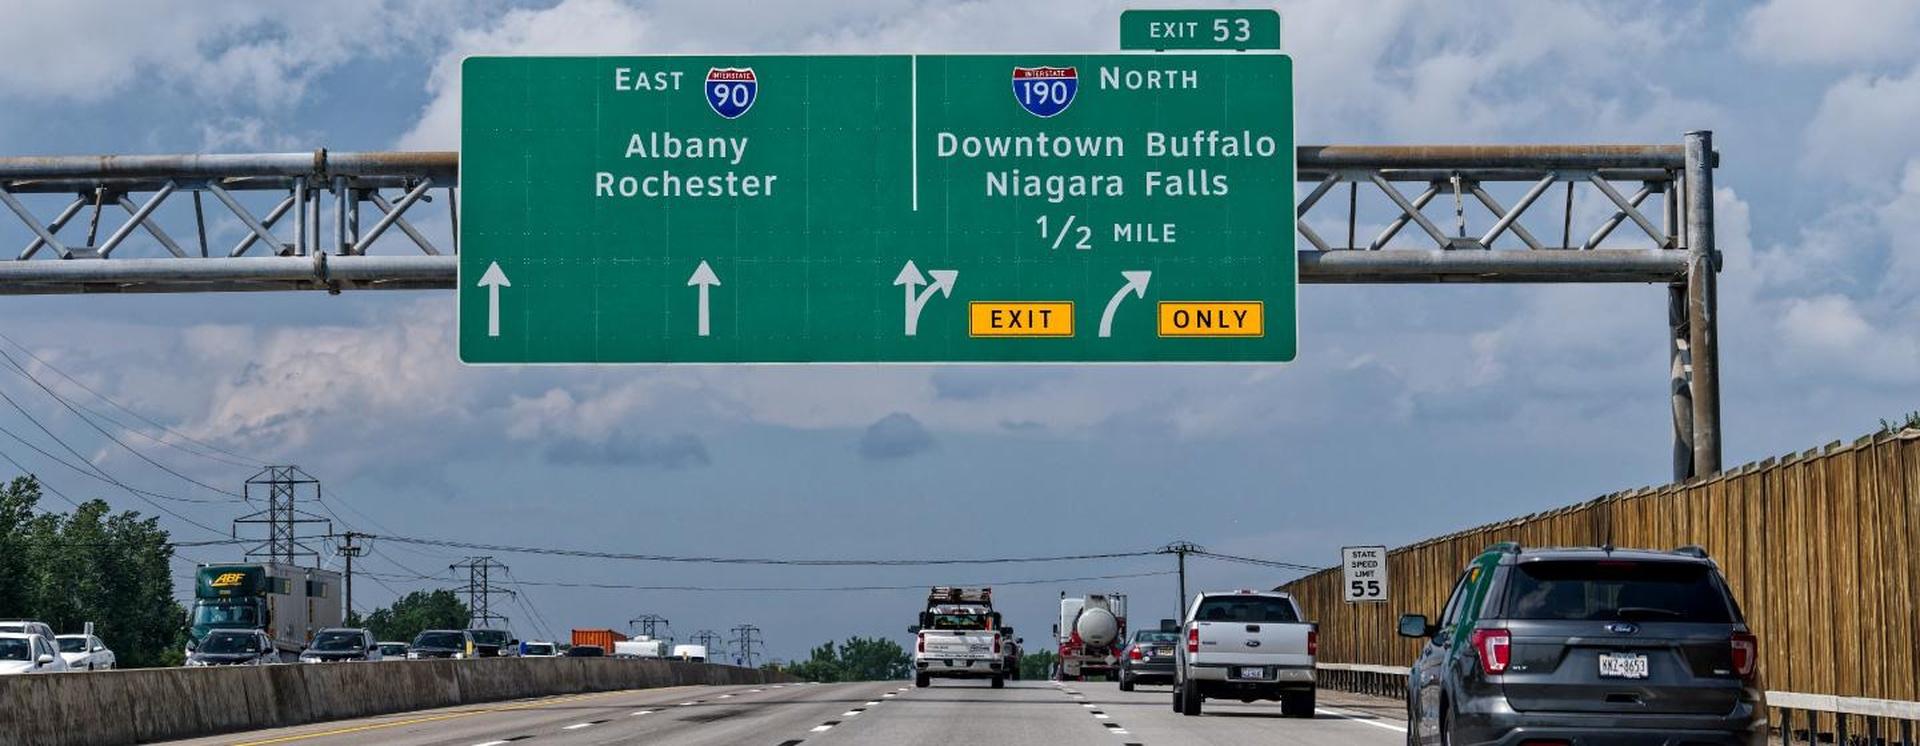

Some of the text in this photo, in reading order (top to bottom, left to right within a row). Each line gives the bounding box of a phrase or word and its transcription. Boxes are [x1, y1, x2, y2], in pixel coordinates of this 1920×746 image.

[1150, 18, 1251, 42] EXIT 53
[615, 67, 684, 91] EAST
[1100, 66, 1198, 90] NORTH
[714, 83, 749, 107] 90
[1023, 81, 1068, 105] 190
[625, 132, 748, 165] Albany
[937, 131, 1277, 158] Downtown Buffalo
[595, 170, 778, 198] Rochester
[986, 169, 1229, 203] Niagara Falls
[1036, 215, 1177, 250] 1/2 MILE
[991, 309, 1052, 329] EXIT
[1173, 309, 1248, 329] ONLY
[1351, 560, 1378, 569] SPEED
[1352, 550, 1377, 558] STATE
[213, 573, 246, 585] ABF
[1355, 570, 1375, 578] LIMIT
[1351, 580, 1380, 598] 55
